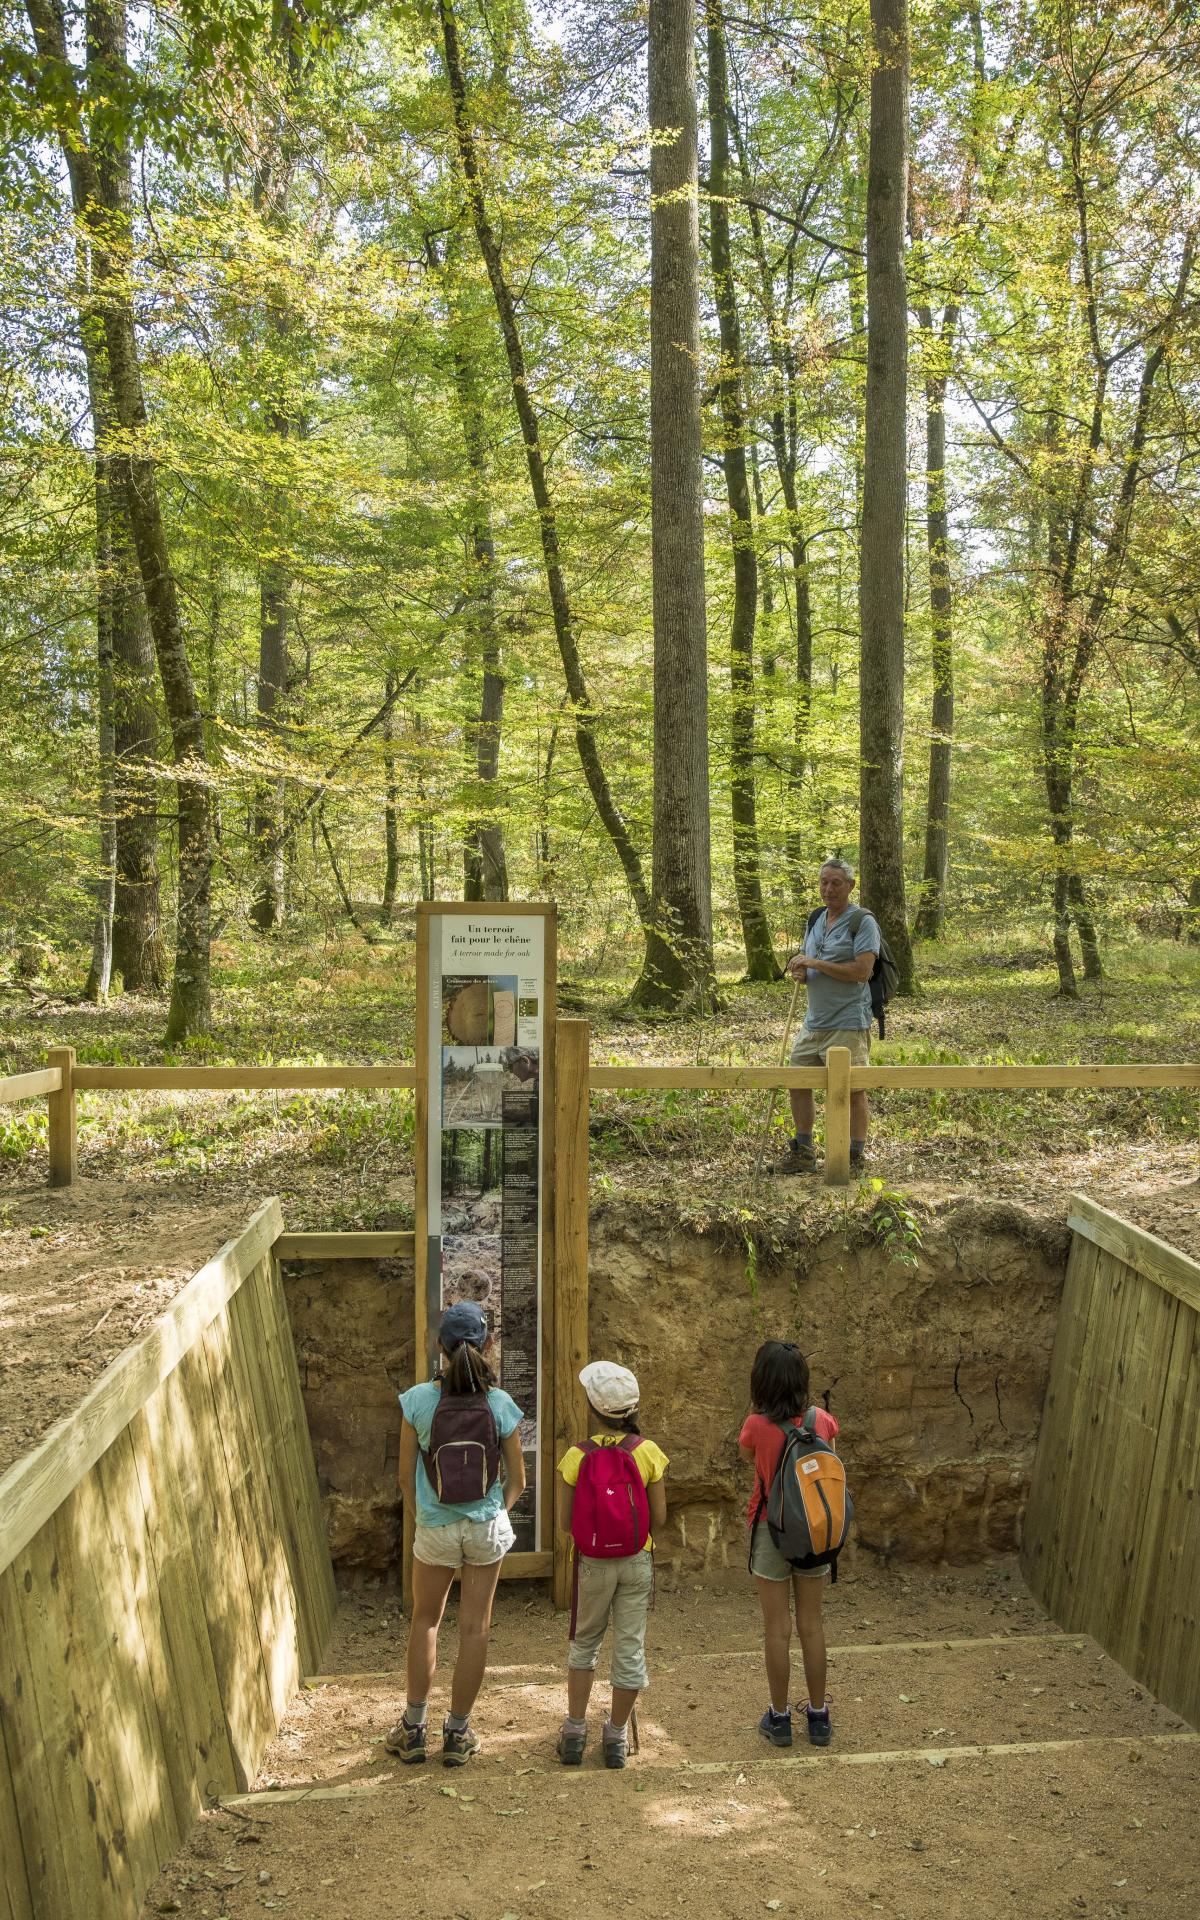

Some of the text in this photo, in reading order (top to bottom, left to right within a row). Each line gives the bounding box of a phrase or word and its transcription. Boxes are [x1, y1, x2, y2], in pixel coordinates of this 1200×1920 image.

[468, 924, 515, 933] Un terroir
[451, 935, 531, 945] fait pour le chêne
[459, 949, 482, 957] terroir
[483, 949, 504, 957] made
[504, 948, 515, 958] for
[517, 949, 530, 957] oak
